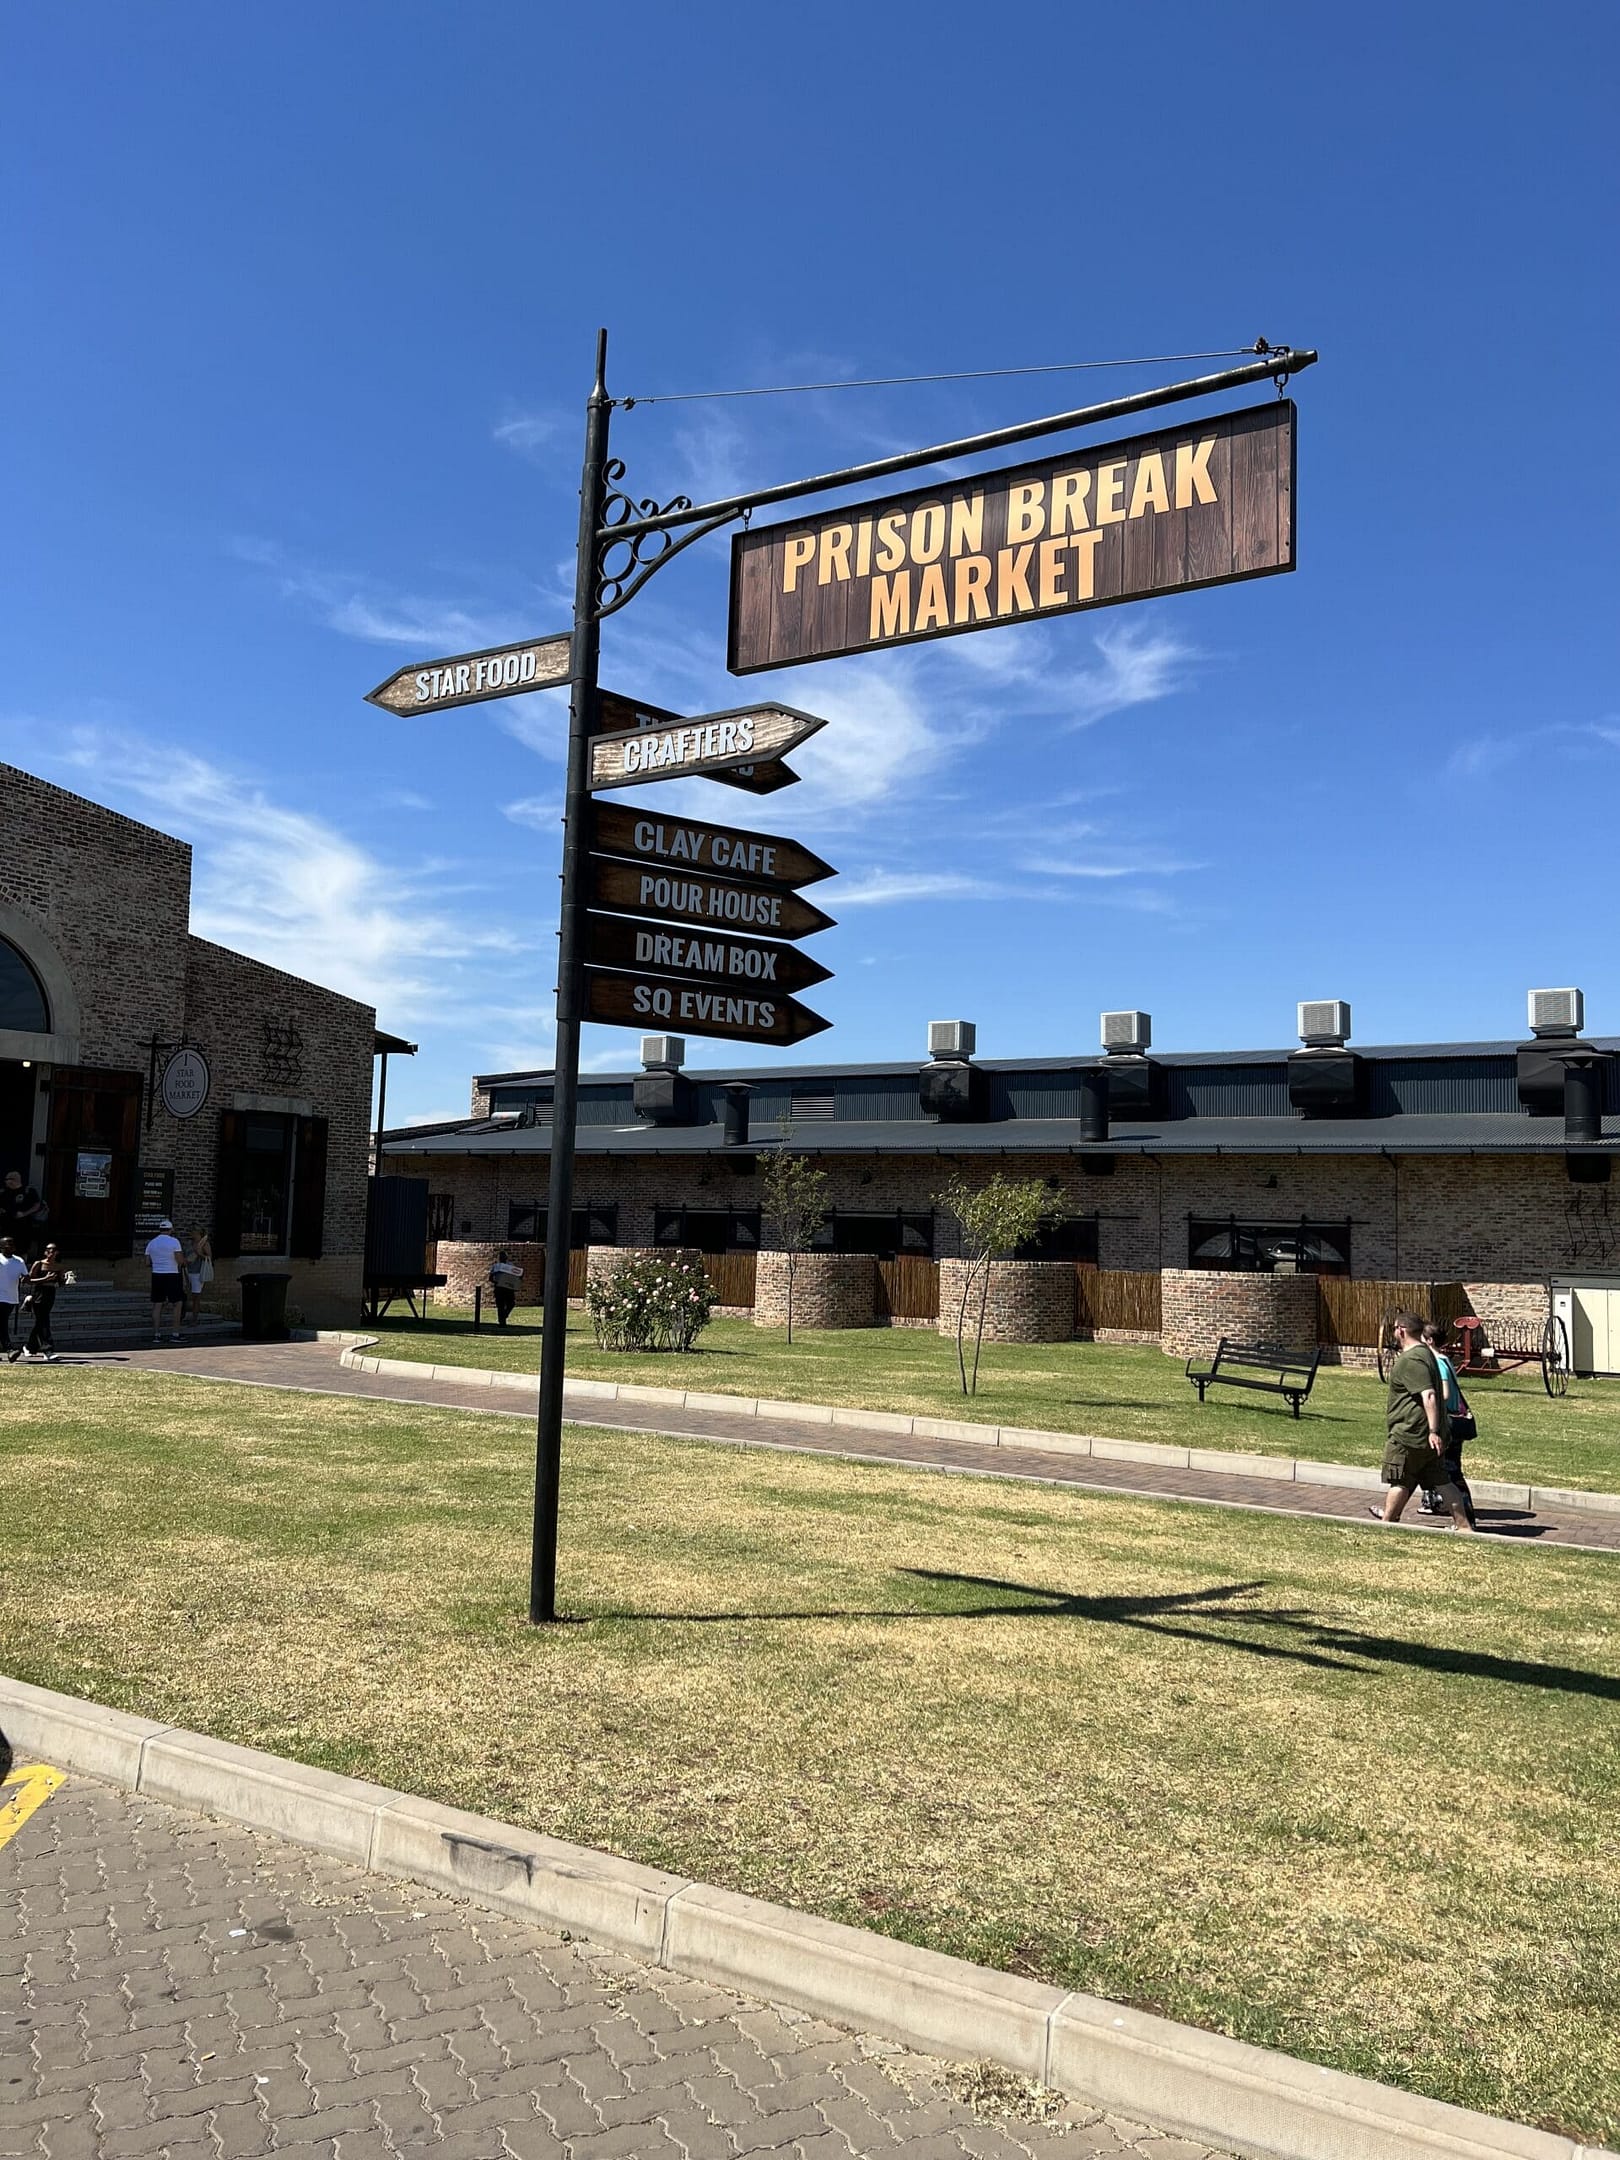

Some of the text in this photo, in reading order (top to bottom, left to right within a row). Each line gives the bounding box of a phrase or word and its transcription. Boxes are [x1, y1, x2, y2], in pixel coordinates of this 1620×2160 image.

[783, 433, 1218, 593] PRISON BREAK
[869, 528, 1104, 640] MARKET
[415, 652, 536, 701] STAR FOOD
[623, 718, 754, 773] CRAFTERS
[634, 821, 777, 876] CLAY CAFE
[640, 875, 782, 927] POUR HOUSE
[635, 932, 778, 981] DREAM BOX
[633, 985, 776, 1028] SQ EVENTS
[169, 1090, 201, 1100] MARKET
[175, 1069, 194, 1078] STAR
[175, 1080, 196, 1089] FOOD
